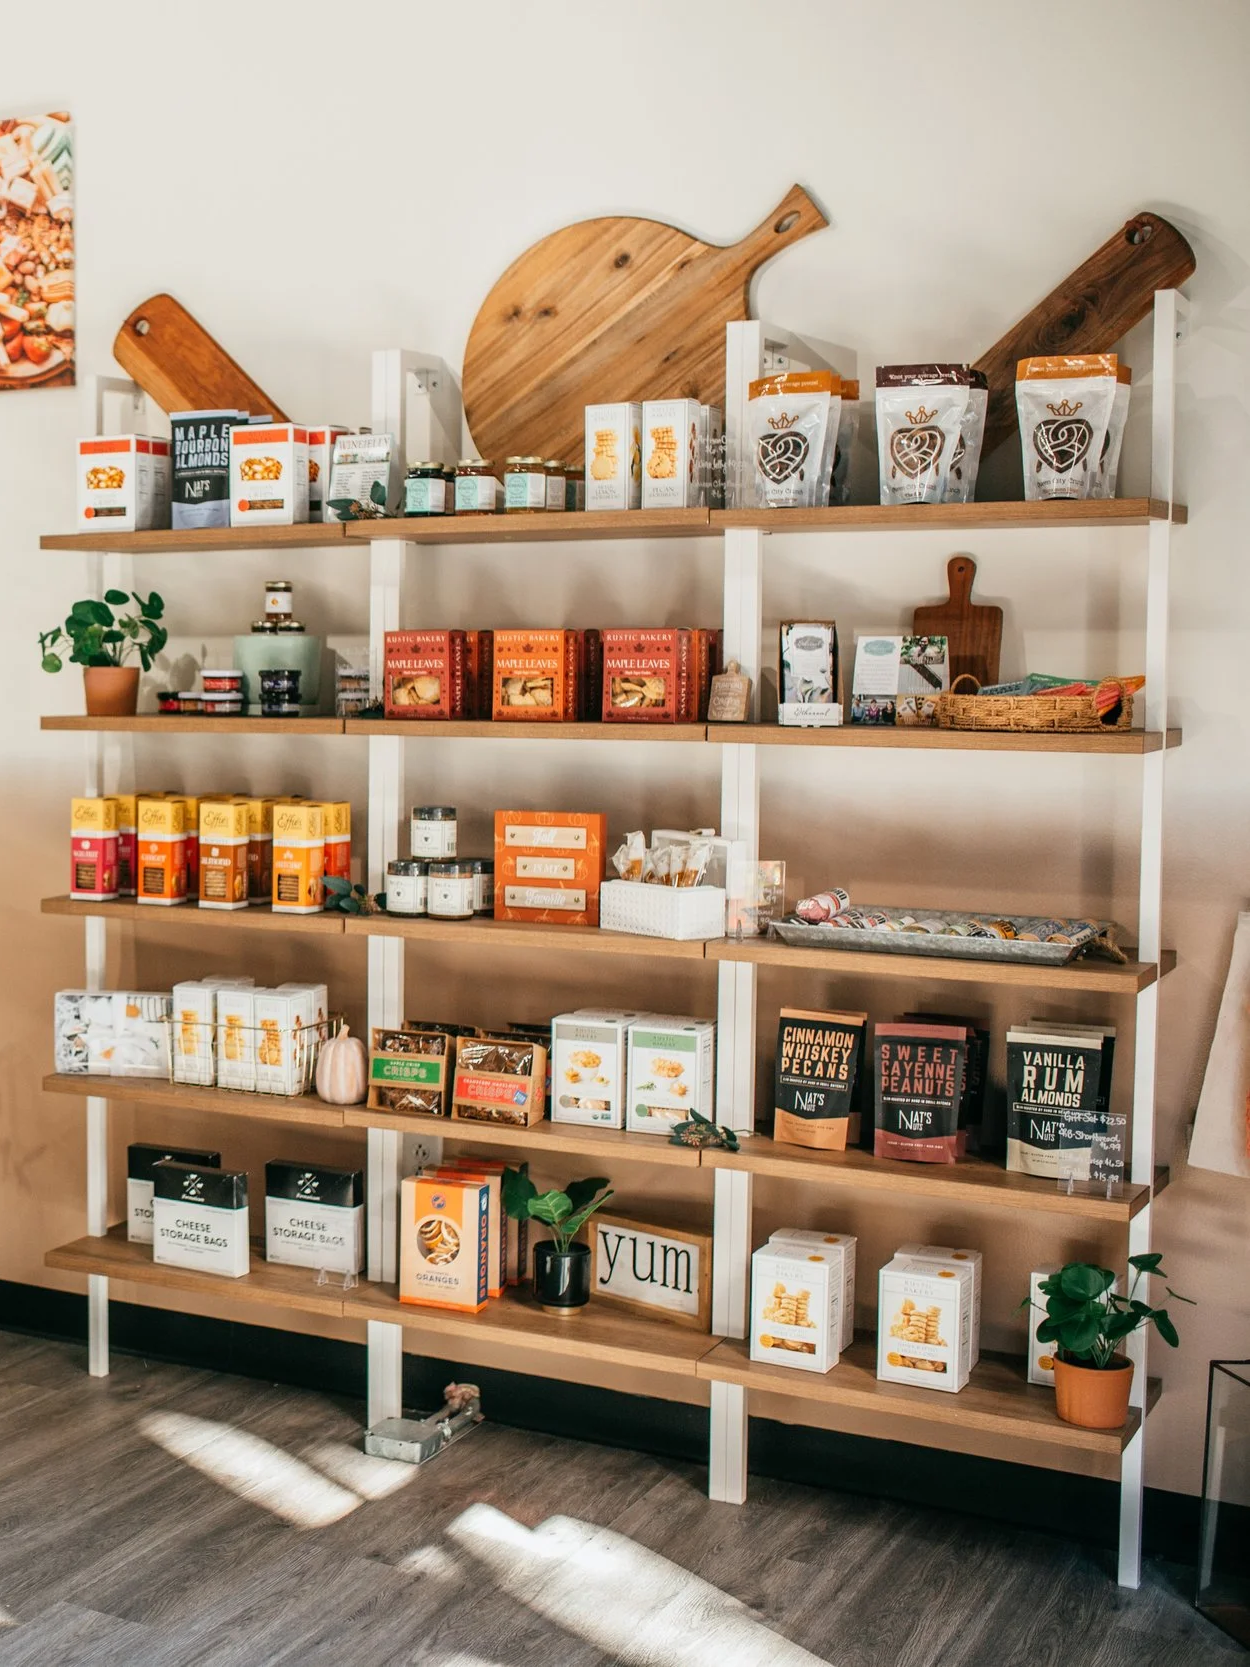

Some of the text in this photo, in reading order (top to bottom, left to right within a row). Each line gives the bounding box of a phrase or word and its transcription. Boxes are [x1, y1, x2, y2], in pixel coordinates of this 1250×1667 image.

[175, 424, 230, 441] MAPLE
[175, 438, 229, 455] BOURBON
[175, 452, 229, 469] ALMONDS
[386, 635, 446, 643] RUSTIC BAKERY
[496, 634, 560, 642] RUSTIC BAKERY
[387, 660, 445, 669] MAPLE LEAVES
[497, 660, 559, 669] MAPLE LEAVES
[606, 659, 670, 669] MAPLE LEAVES
[783, 1026, 855, 1049] CINNAMON
[782, 1042, 852, 1064] WHISKEY
[881, 1044, 959, 1065] SWEET
[1023, 1051, 1085, 1069] VANILLA
[383, 1066, 427, 1079] CRISPS
[781, 1057, 849, 1080] PECANS
[881, 1060, 956, 1080] CAYENNE
[881, 1076, 955, 1097] PEANUTS
[1022, 1065, 1085, 1093] RUM
[467, 1085, 513, 1100] CRISPS
[794, 1090, 825, 1111] NAT'S
[1021, 1088, 1081, 1108] ALMONDS
[898, 1109, 932, 1130] NAT'S
[1100, 1114, 1126, 1125] $22.50
[175, 1218, 212, 1233] CHEESE
[289, 1218, 328, 1232] CHEESE
[160, 1228, 201, 1243] STORAGE
[203, 1235, 229, 1248] BAGS
[273, 1227, 347, 1247] STORAGE BAGS
[416, 1272, 460, 1285] ORANGES
